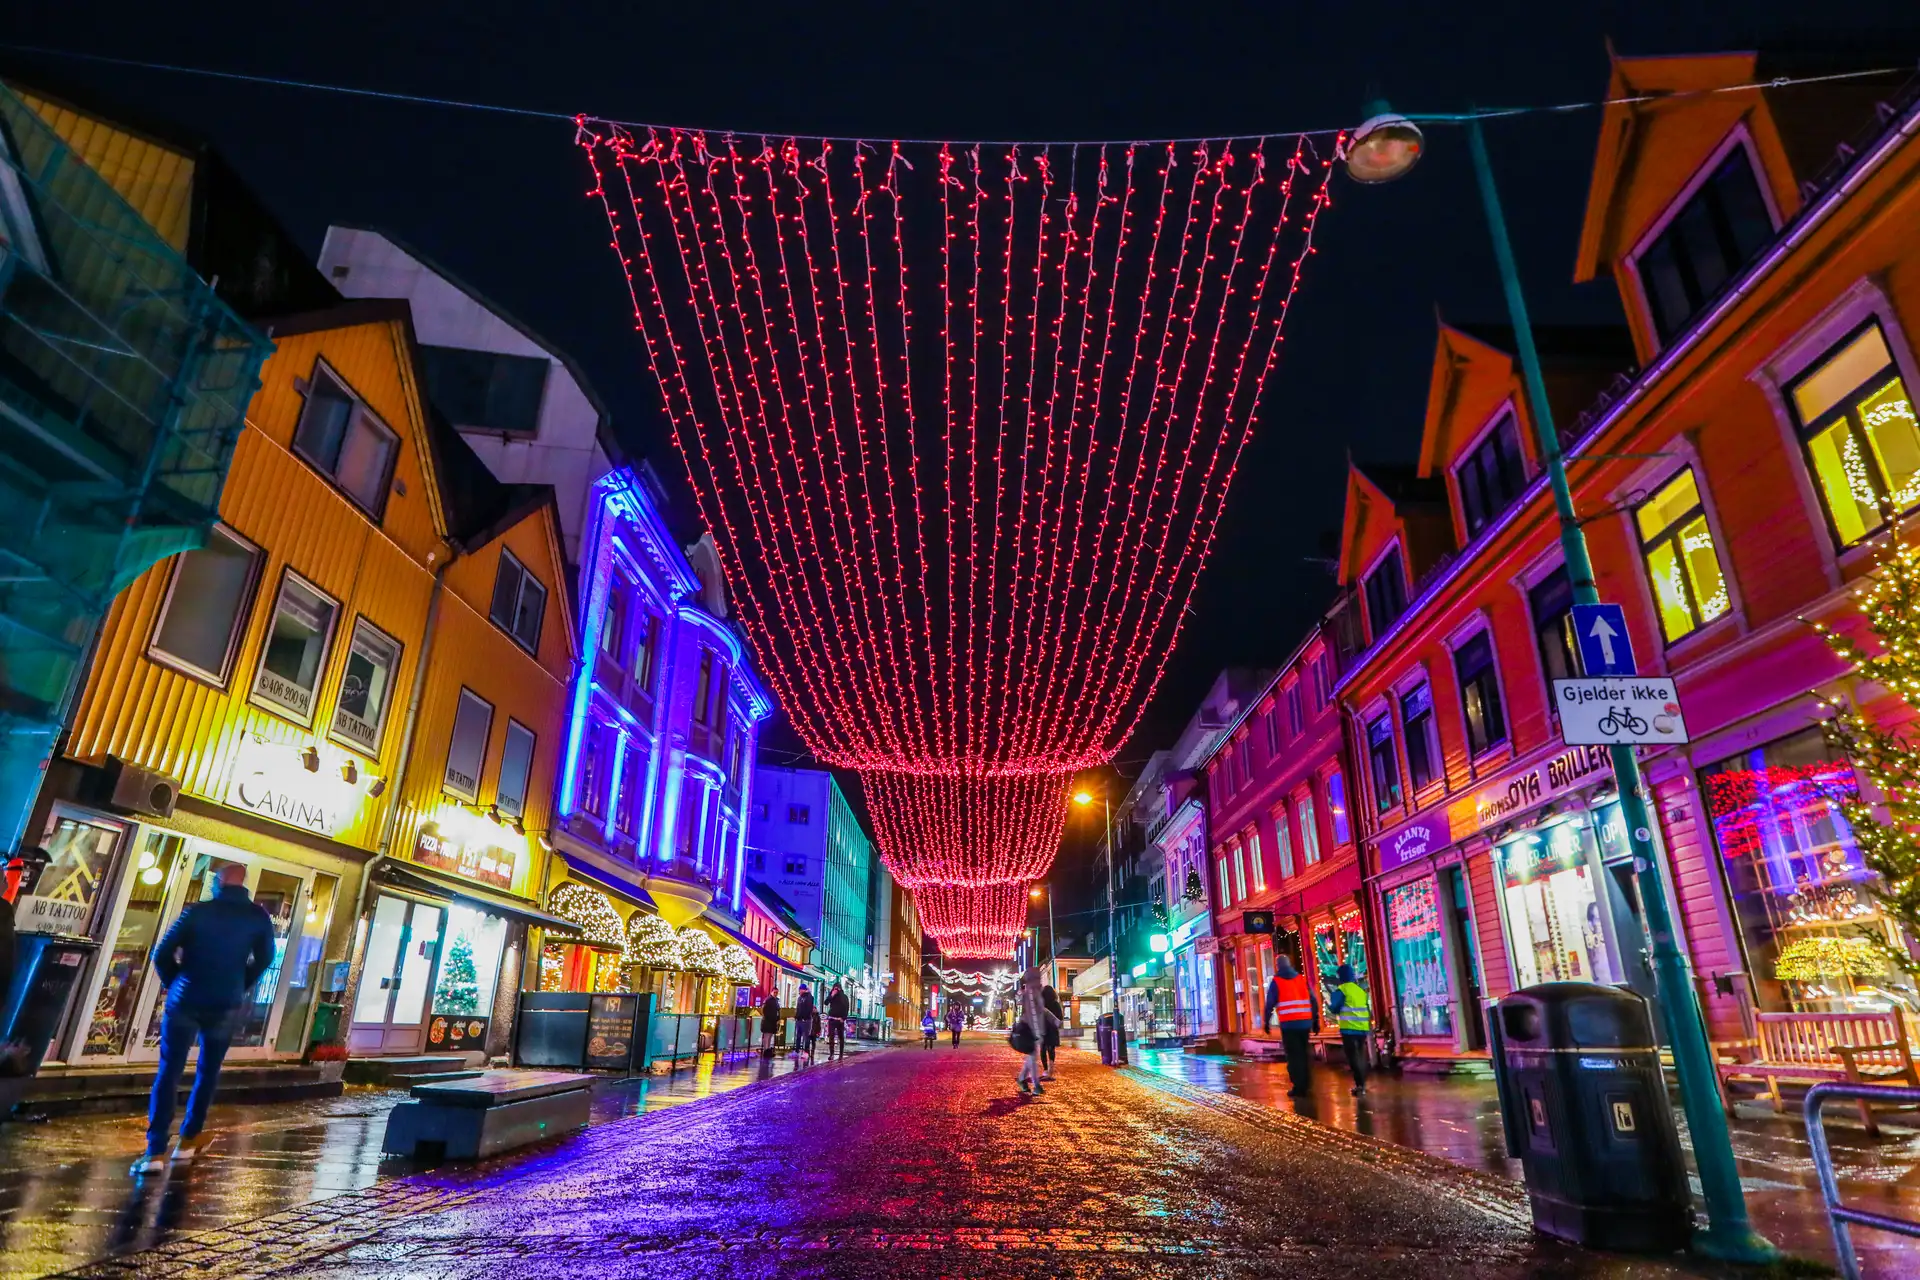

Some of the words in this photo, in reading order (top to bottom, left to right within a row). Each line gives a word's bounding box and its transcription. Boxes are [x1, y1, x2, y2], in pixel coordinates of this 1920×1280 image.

[268, 678, 283, 697] 406
[284, 684, 299, 704] 200
[1563, 686, 1626, 705] Gjelder
[1632, 685, 1668, 700] ikke
[348, 718, 375, 740] TATTOO
[455, 772, 475, 791] TATTOO
[238, 771, 324, 830] CARINA
[420, 834, 438, 852] PIZZA
[1394, 826, 1431, 854] ALANYA
[32, 900, 47, 917] NB
[49, 904, 87, 921] TATTOO
